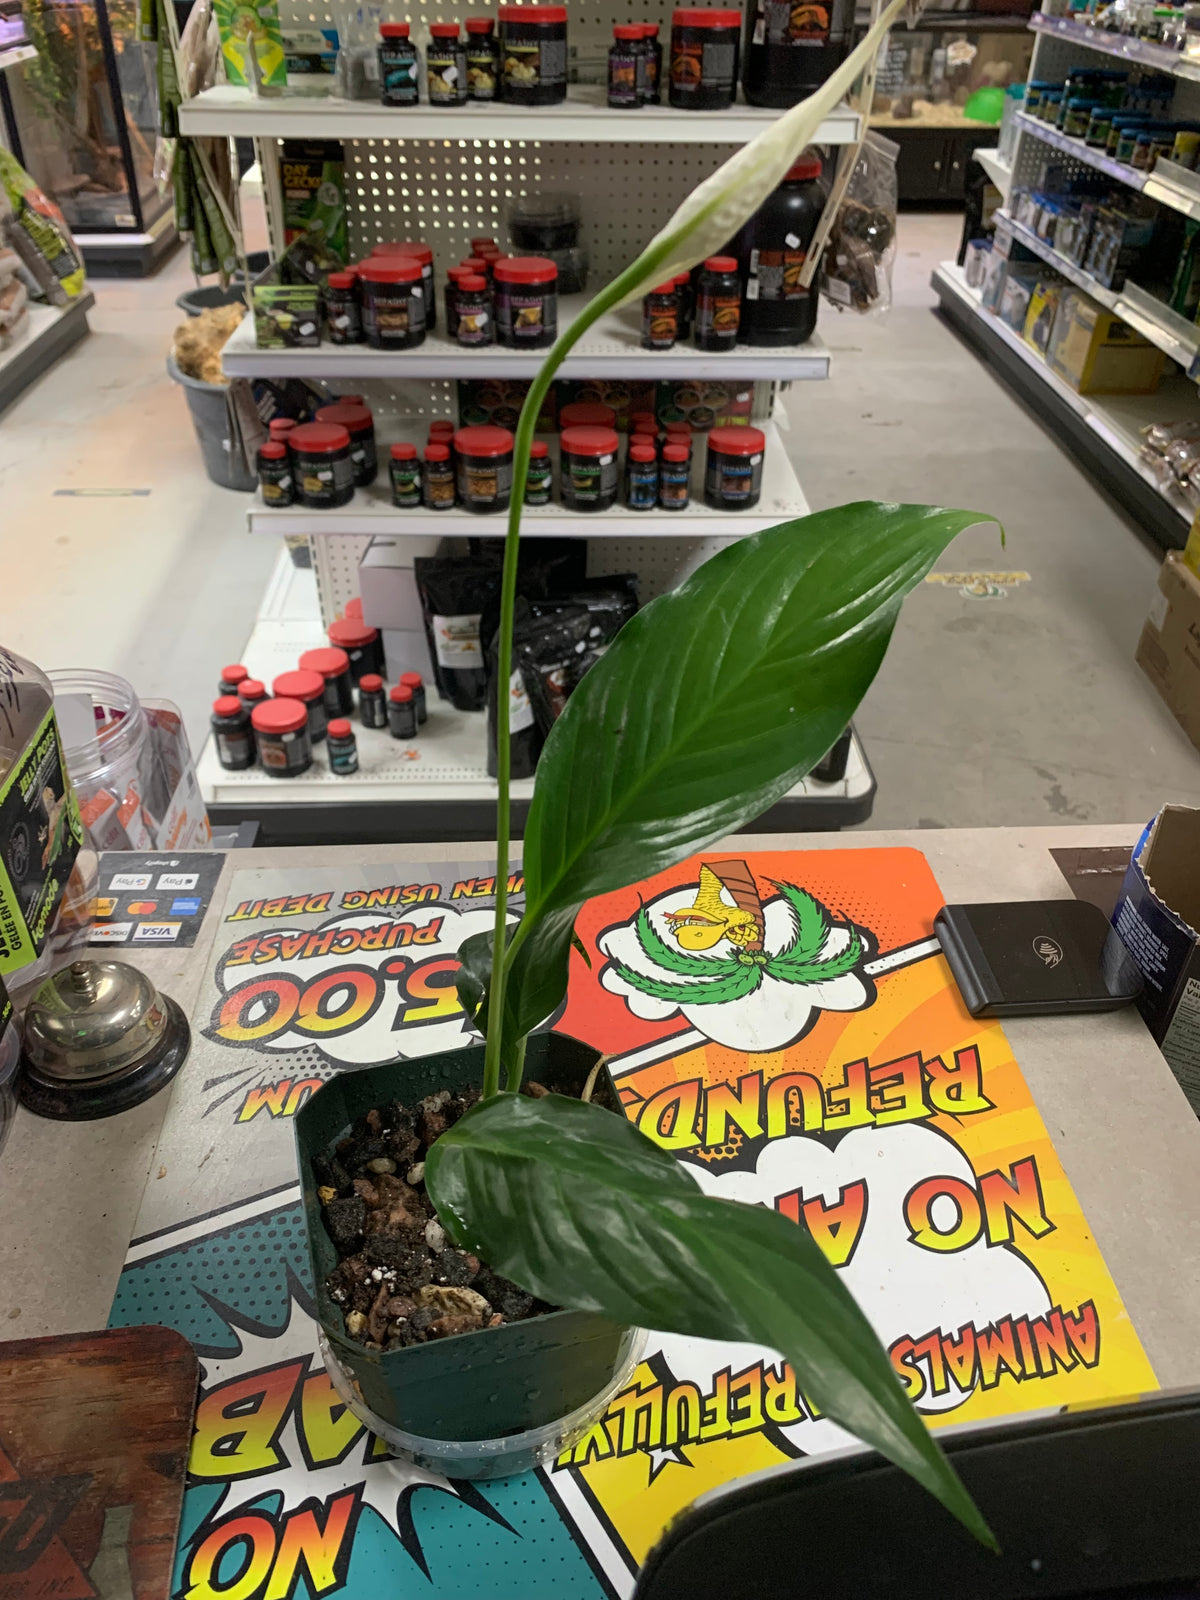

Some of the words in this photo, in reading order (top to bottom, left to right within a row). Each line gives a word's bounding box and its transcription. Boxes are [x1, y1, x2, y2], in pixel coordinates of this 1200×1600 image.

[283, 164, 310, 176] DAY
[20, 756, 37, 797] JELLY
[115, 877, 134, 886] Pay
[162, 877, 183, 886] Pay
[341, 882, 442, 911] USING
[224, 892, 334, 922] DEBIT
[142, 927, 171, 936] VISA
[226, 916, 445, 966] PURCHASE
[904, 1155, 1056, 1254] NO
[886, 1299, 1100, 1400] ANIMALS
[171, 1481, 365, 1600] NO
